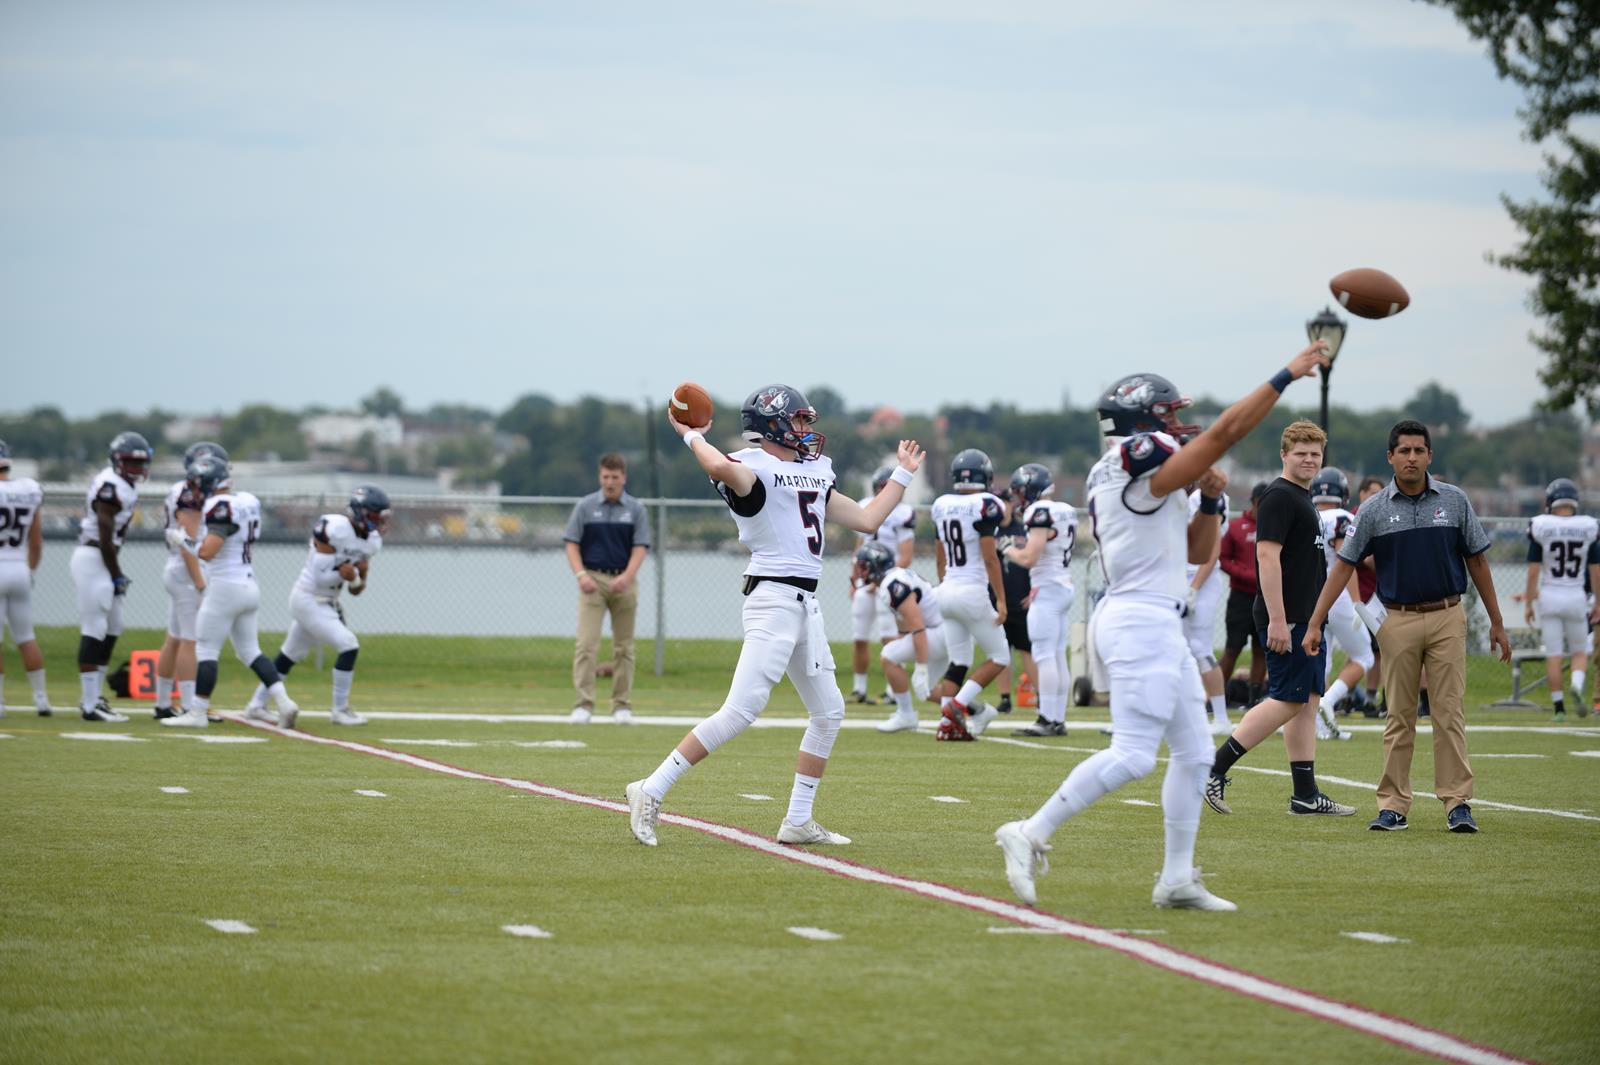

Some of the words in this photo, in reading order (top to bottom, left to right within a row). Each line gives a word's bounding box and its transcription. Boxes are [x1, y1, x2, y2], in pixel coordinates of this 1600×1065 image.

[773, 473, 827, 490] MARITIME
[0, 507, 30, 547] 25
[797, 490, 822, 556] 5
[943, 519, 967, 567] 18
[1550, 540, 1584, 578] 35
